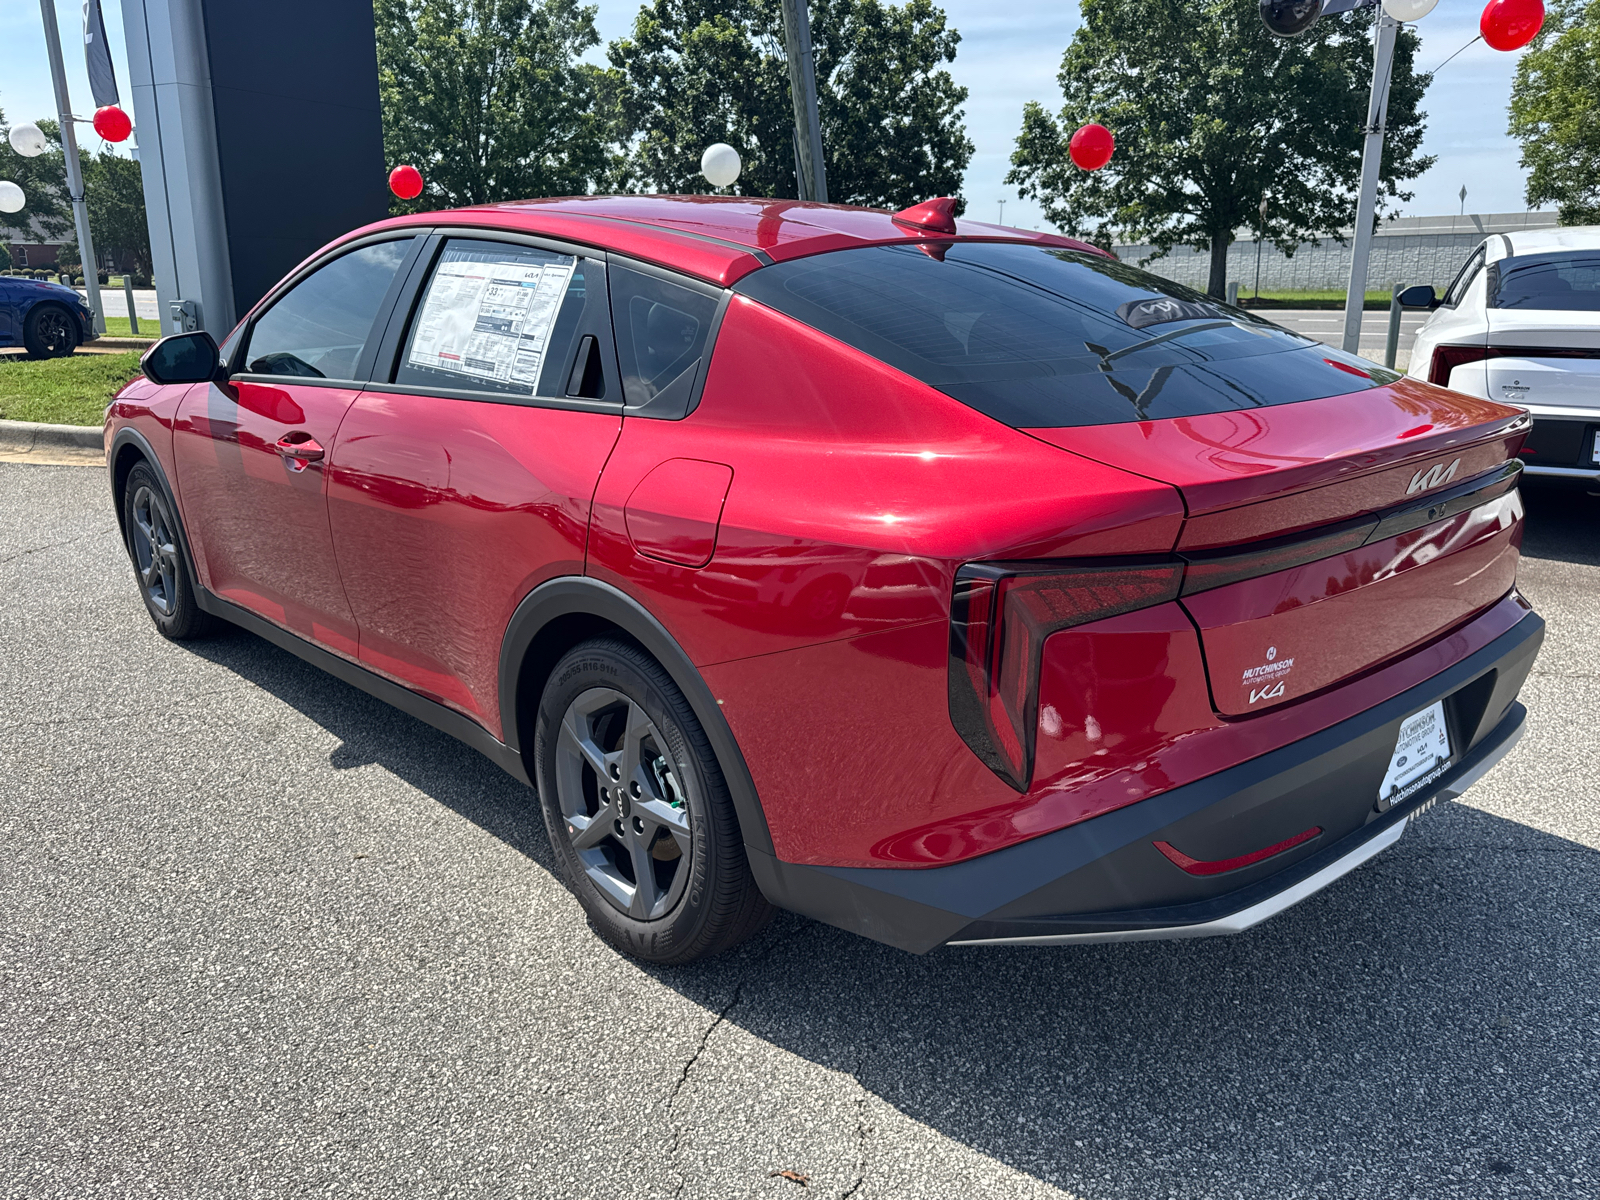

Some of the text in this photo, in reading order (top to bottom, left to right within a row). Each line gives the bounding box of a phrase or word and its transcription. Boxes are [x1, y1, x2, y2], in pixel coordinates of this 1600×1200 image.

[489, 286, 499, 296] 33
[1405, 458, 1461, 495] KIA
[558, 664, 582, 687] 205/55
[582, 662, 599, 672] R16
[600, 663, 619, 677] 91H
[1242, 657, 1295, 680] HUTCHINSON
[1242, 668, 1291, 686] AUTOMOTIVE GROUP
[1248, 681, 1285, 704] K4
[1398, 709, 1436, 744] UTCHINSON
[1421, 724, 1436, 740] GROUP
[690, 814, 707, 908] KUMHO
